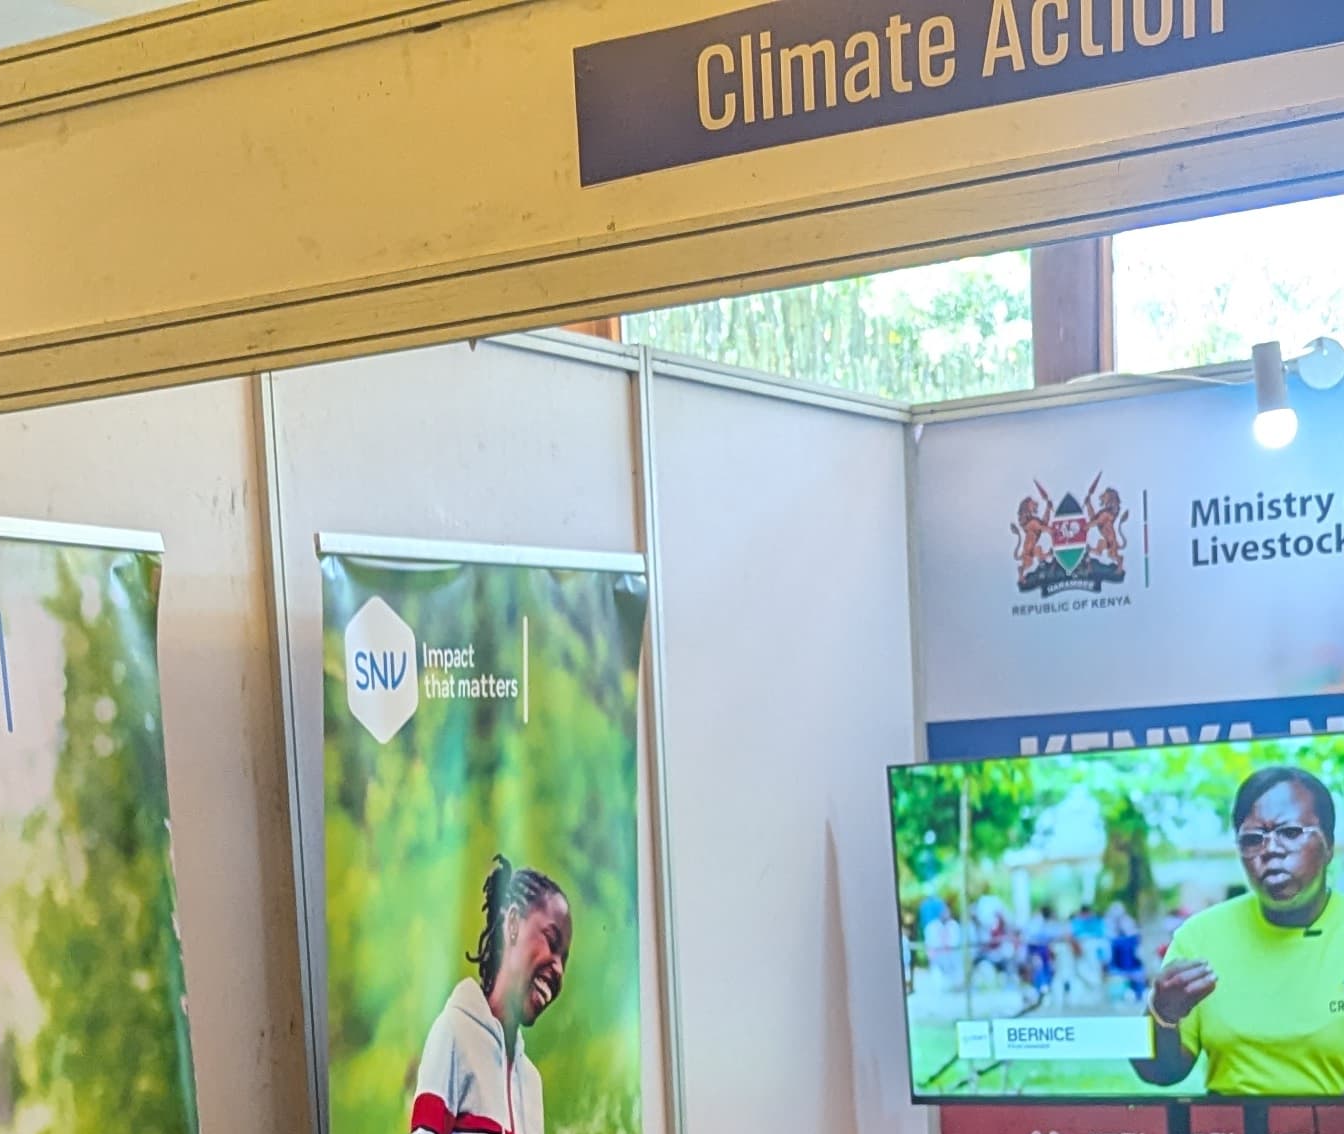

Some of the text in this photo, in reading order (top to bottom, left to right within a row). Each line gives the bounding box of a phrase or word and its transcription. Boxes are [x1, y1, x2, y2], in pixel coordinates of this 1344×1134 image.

[697, 14, 955, 131] Climate
[1190, 489, 1335, 528] Ministry
[1011, 595, 1132, 616] REPUBLIC OF KENYA
[354, 651, 407, 691] SNV
[422, 641, 475, 673] Impact
[424, 673, 519, 699] that matters
[1007, 1026, 1075, 1043] BERNICE
